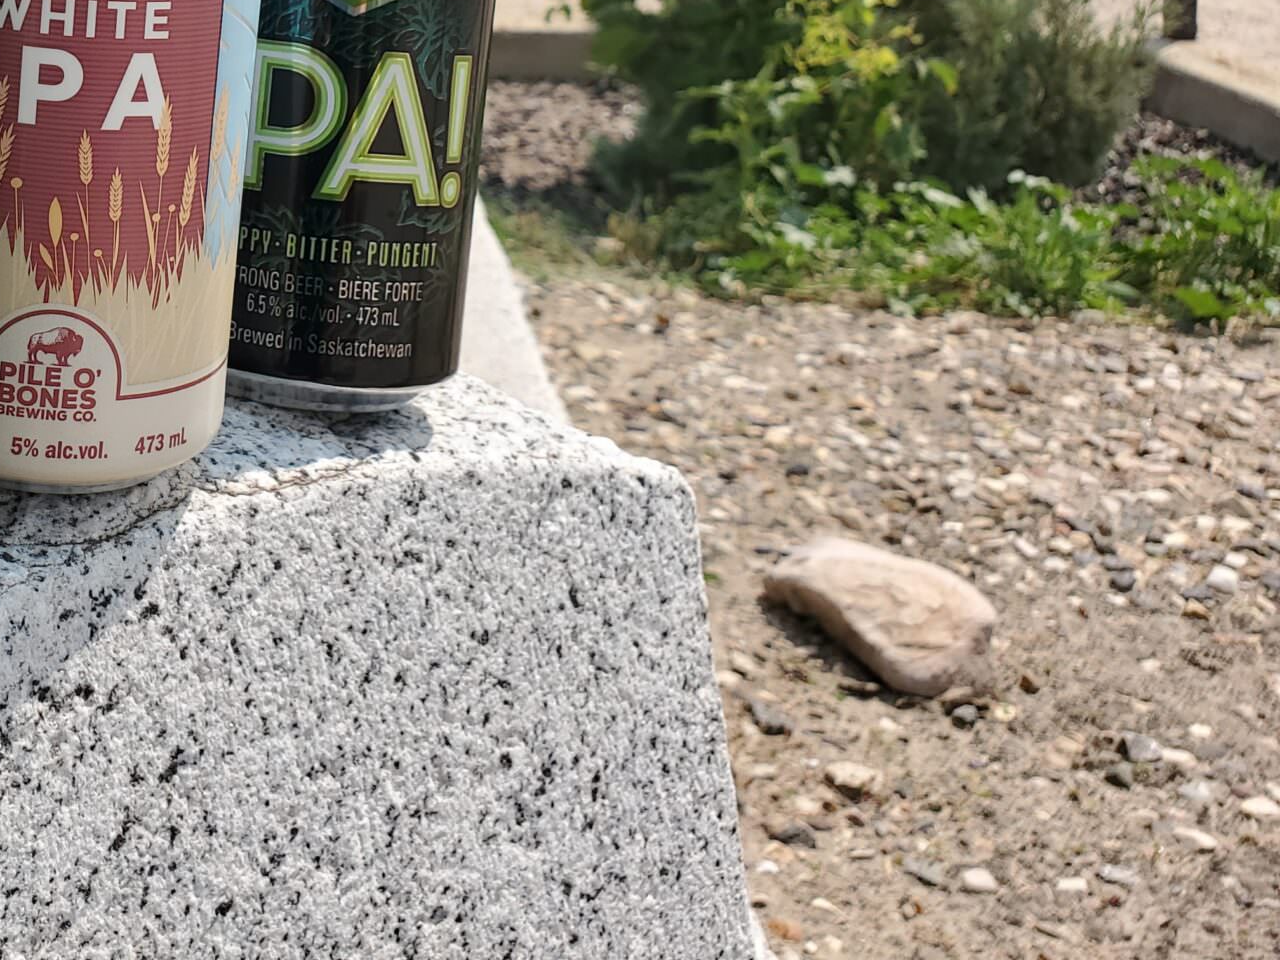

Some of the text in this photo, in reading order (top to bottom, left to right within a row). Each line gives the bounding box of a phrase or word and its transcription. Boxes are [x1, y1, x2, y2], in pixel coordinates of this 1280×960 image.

[243, 39, 473, 209] PA!
[239, 226, 438, 268] PPY BITTER PUNGENT
[236, 264, 280, 290] RONG
[284, 273, 324, 296] BEER
[384, 281, 424, 302] FORTE
[356, 306, 379, 326] 473
[381, 307, 400, 326] mL
[229, 320, 412, 359] Brewed in Saskatchewan
[0, 361, 102, 389] PILE O'
[72, 410, 97, 423] CO.
[10, 437, 39, 458] 5%
[45, 441, 108, 460] alc.vol.
[134, 435, 164, 456] 473
[168, 427, 187, 450] mL
